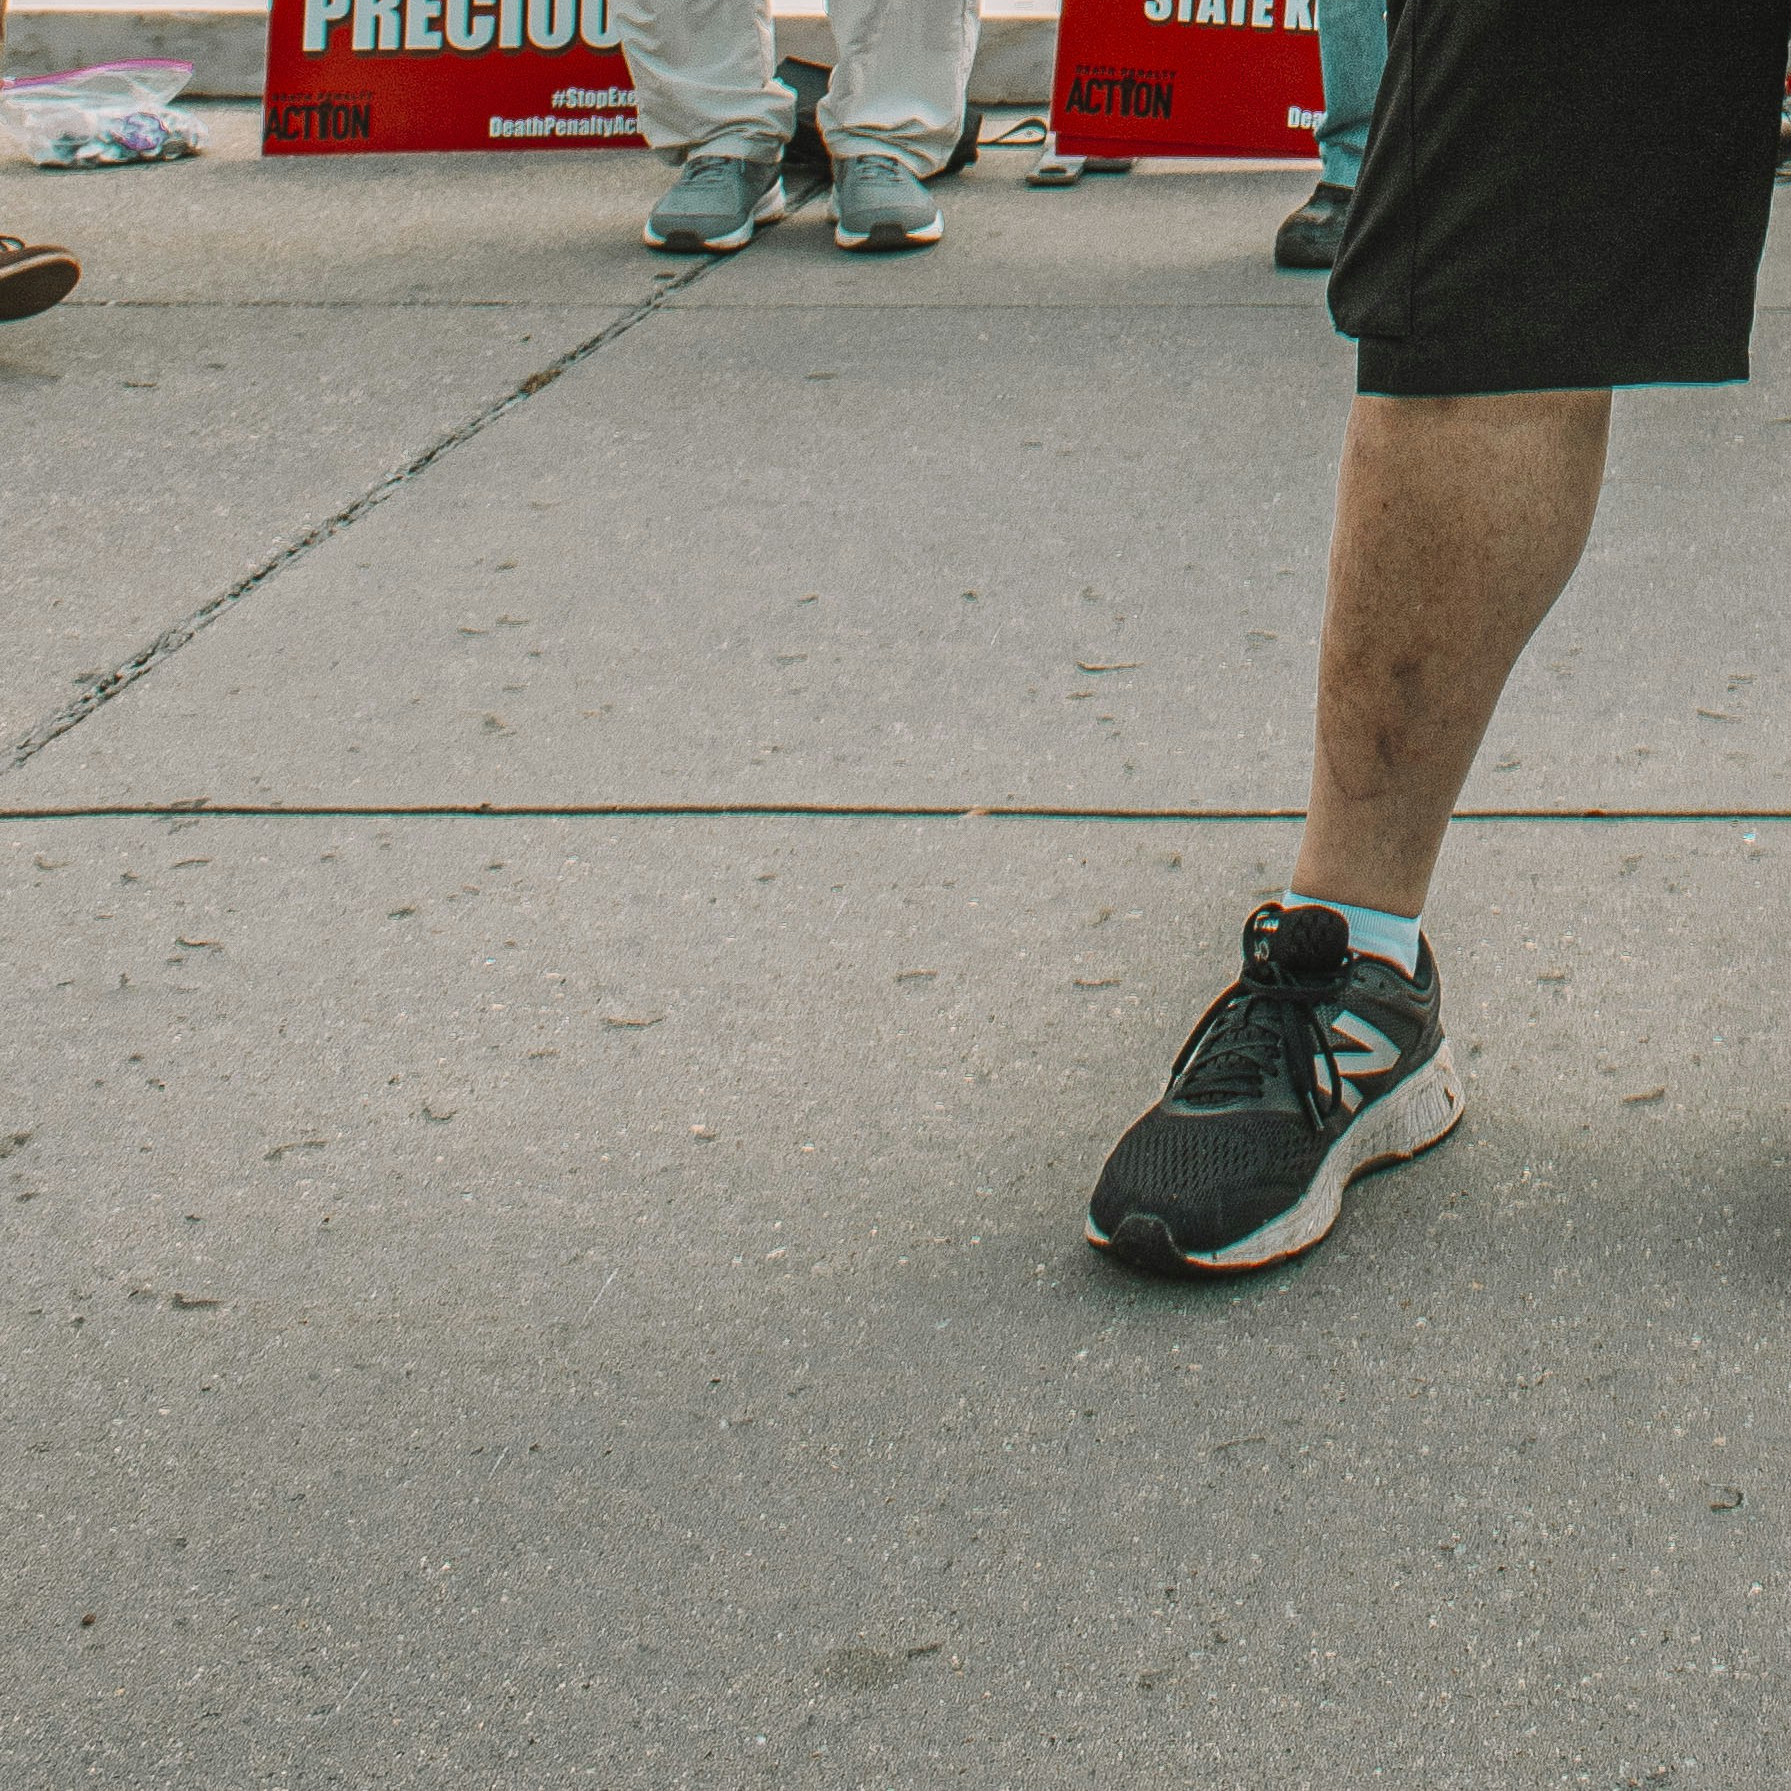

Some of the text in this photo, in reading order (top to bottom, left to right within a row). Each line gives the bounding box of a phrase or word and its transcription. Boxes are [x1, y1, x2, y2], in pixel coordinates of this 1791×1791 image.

[552, 87, 638, 108] #StopExe
[1065, 78, 1174, 119] ACTION
[265, 103, 370, 140] ACTION
[489, 115, 638, 139] DeathPenaltyAc
